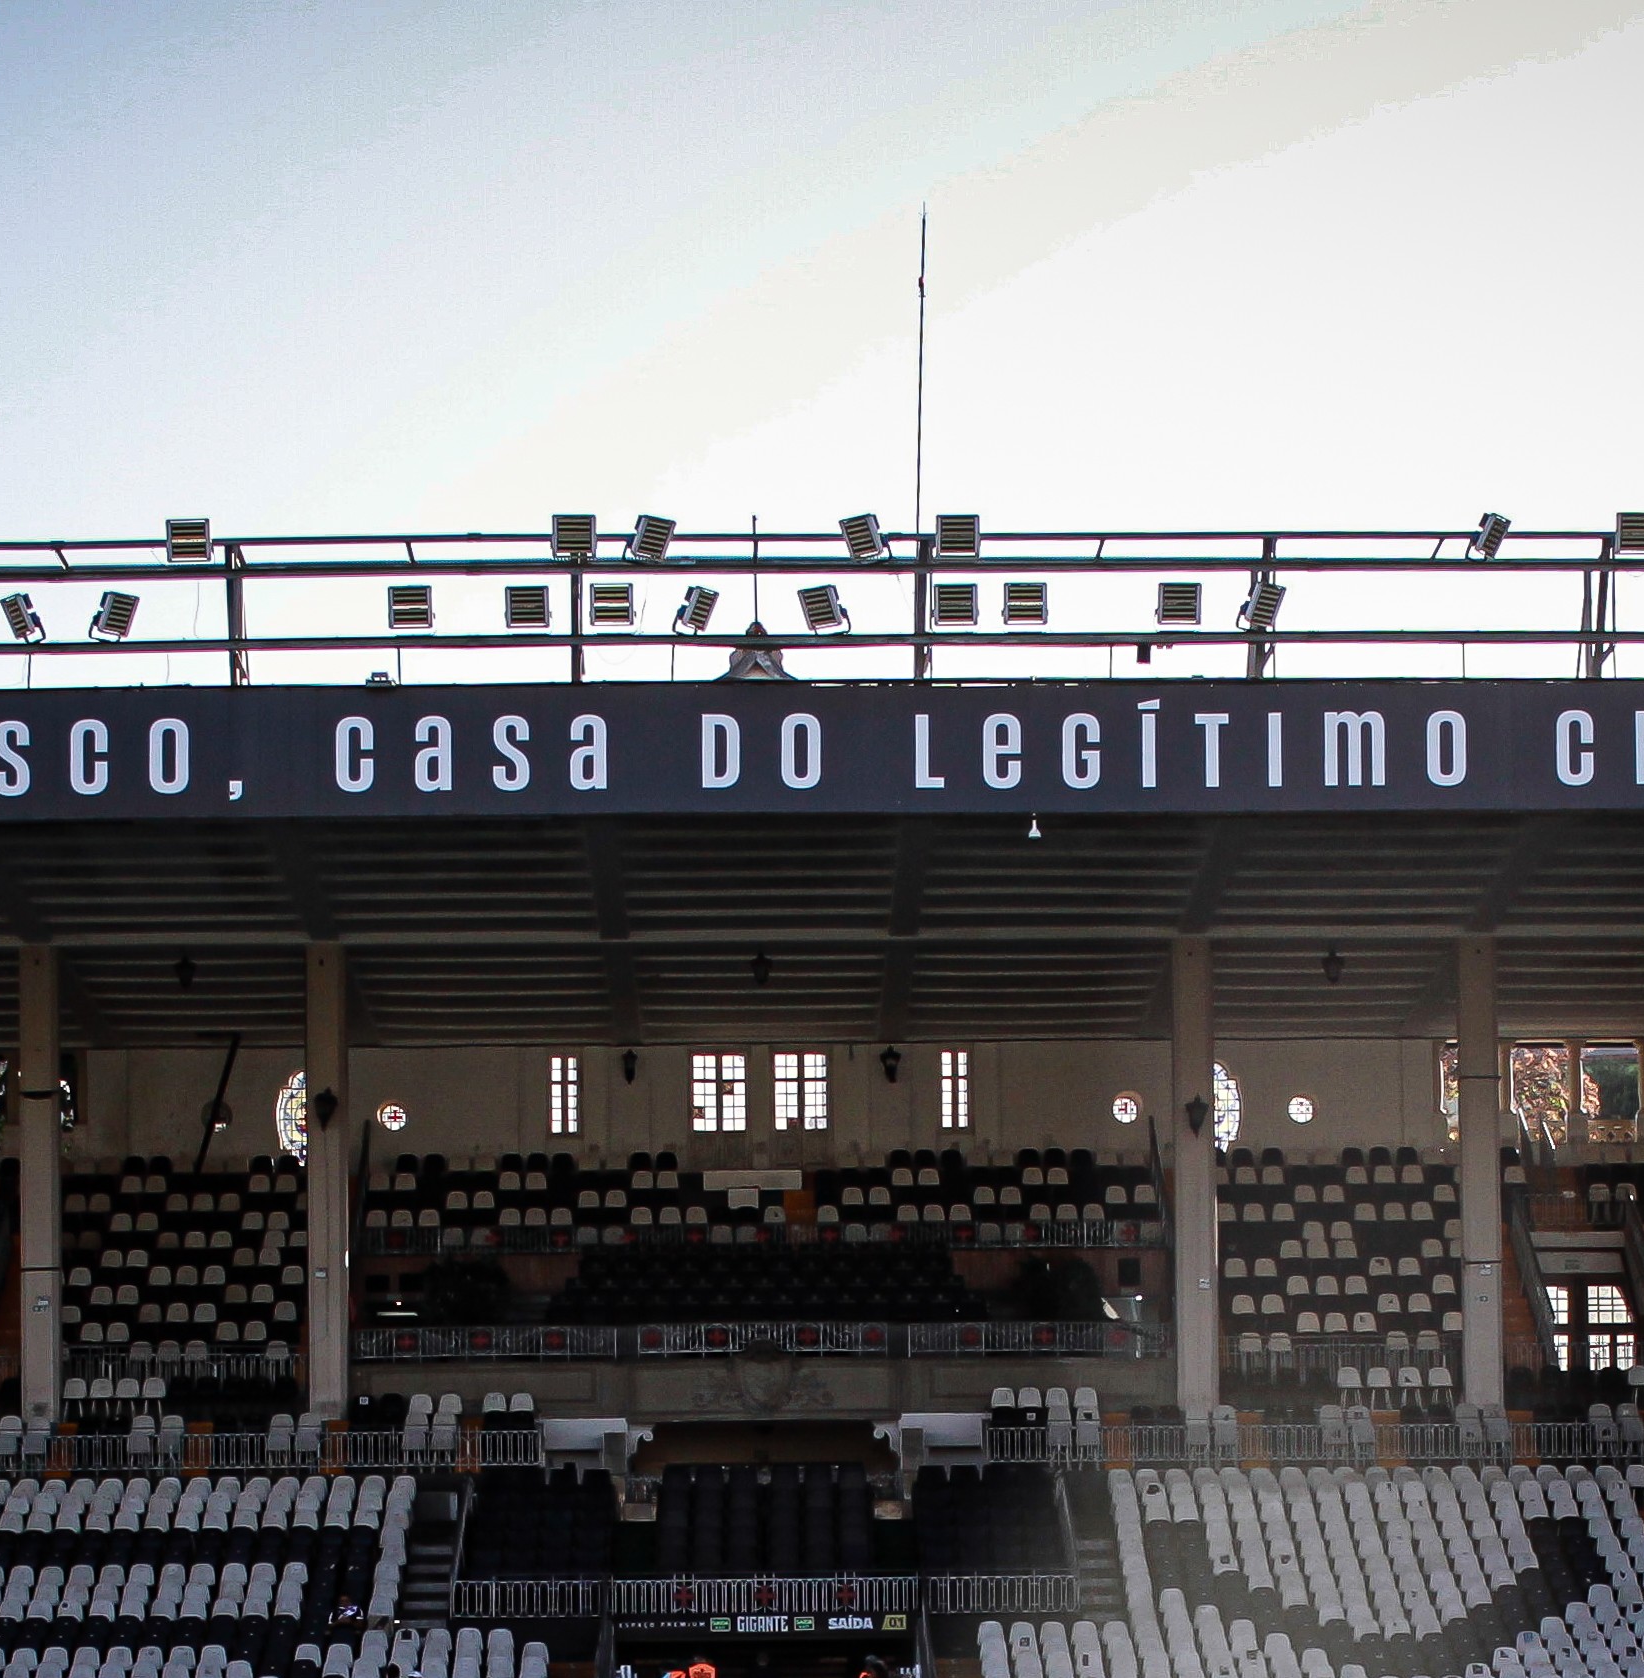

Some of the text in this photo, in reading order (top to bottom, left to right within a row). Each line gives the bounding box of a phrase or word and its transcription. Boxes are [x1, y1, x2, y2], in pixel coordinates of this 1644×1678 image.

[700, 712, 822, 790] DO
[737, 1616, 788, 1632] GIGANTE
[828, 1614, 873, 1630] SAÍDA
